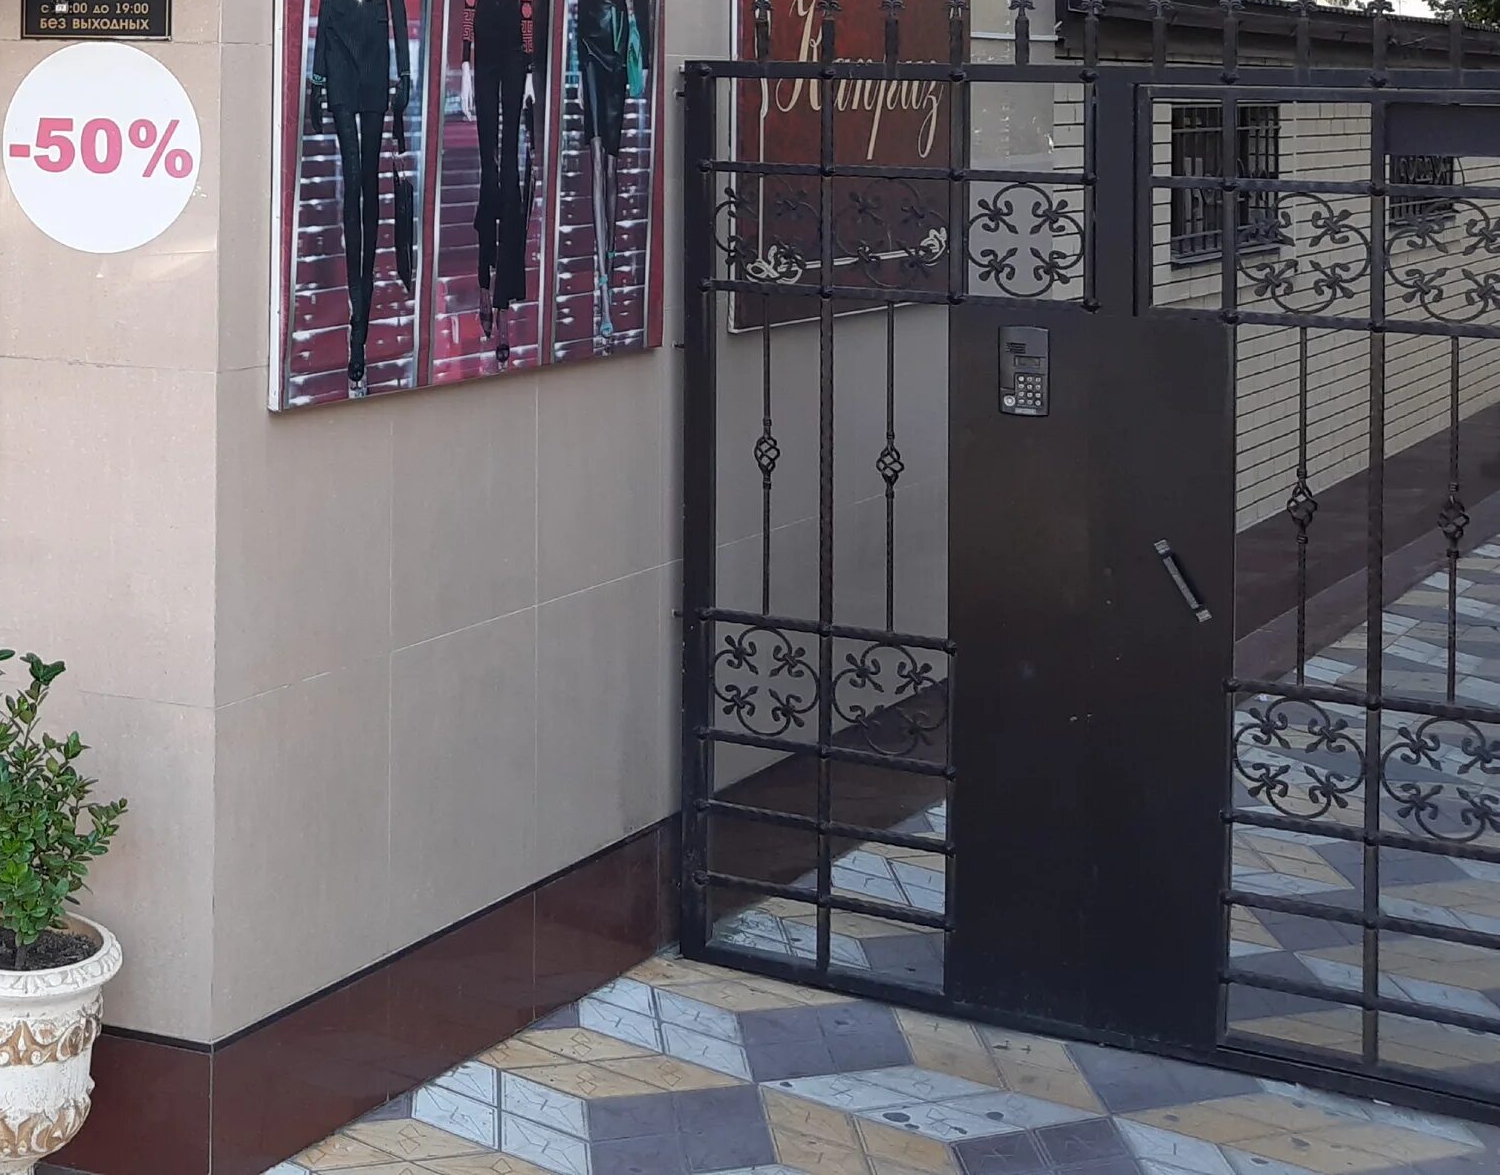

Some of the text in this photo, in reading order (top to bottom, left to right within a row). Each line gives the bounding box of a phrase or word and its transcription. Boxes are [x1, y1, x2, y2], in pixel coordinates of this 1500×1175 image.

[53, 3, 88, 15] :00
[116, 3, 149, 15] 19:00
[9, 117, 193, 178] -50%
